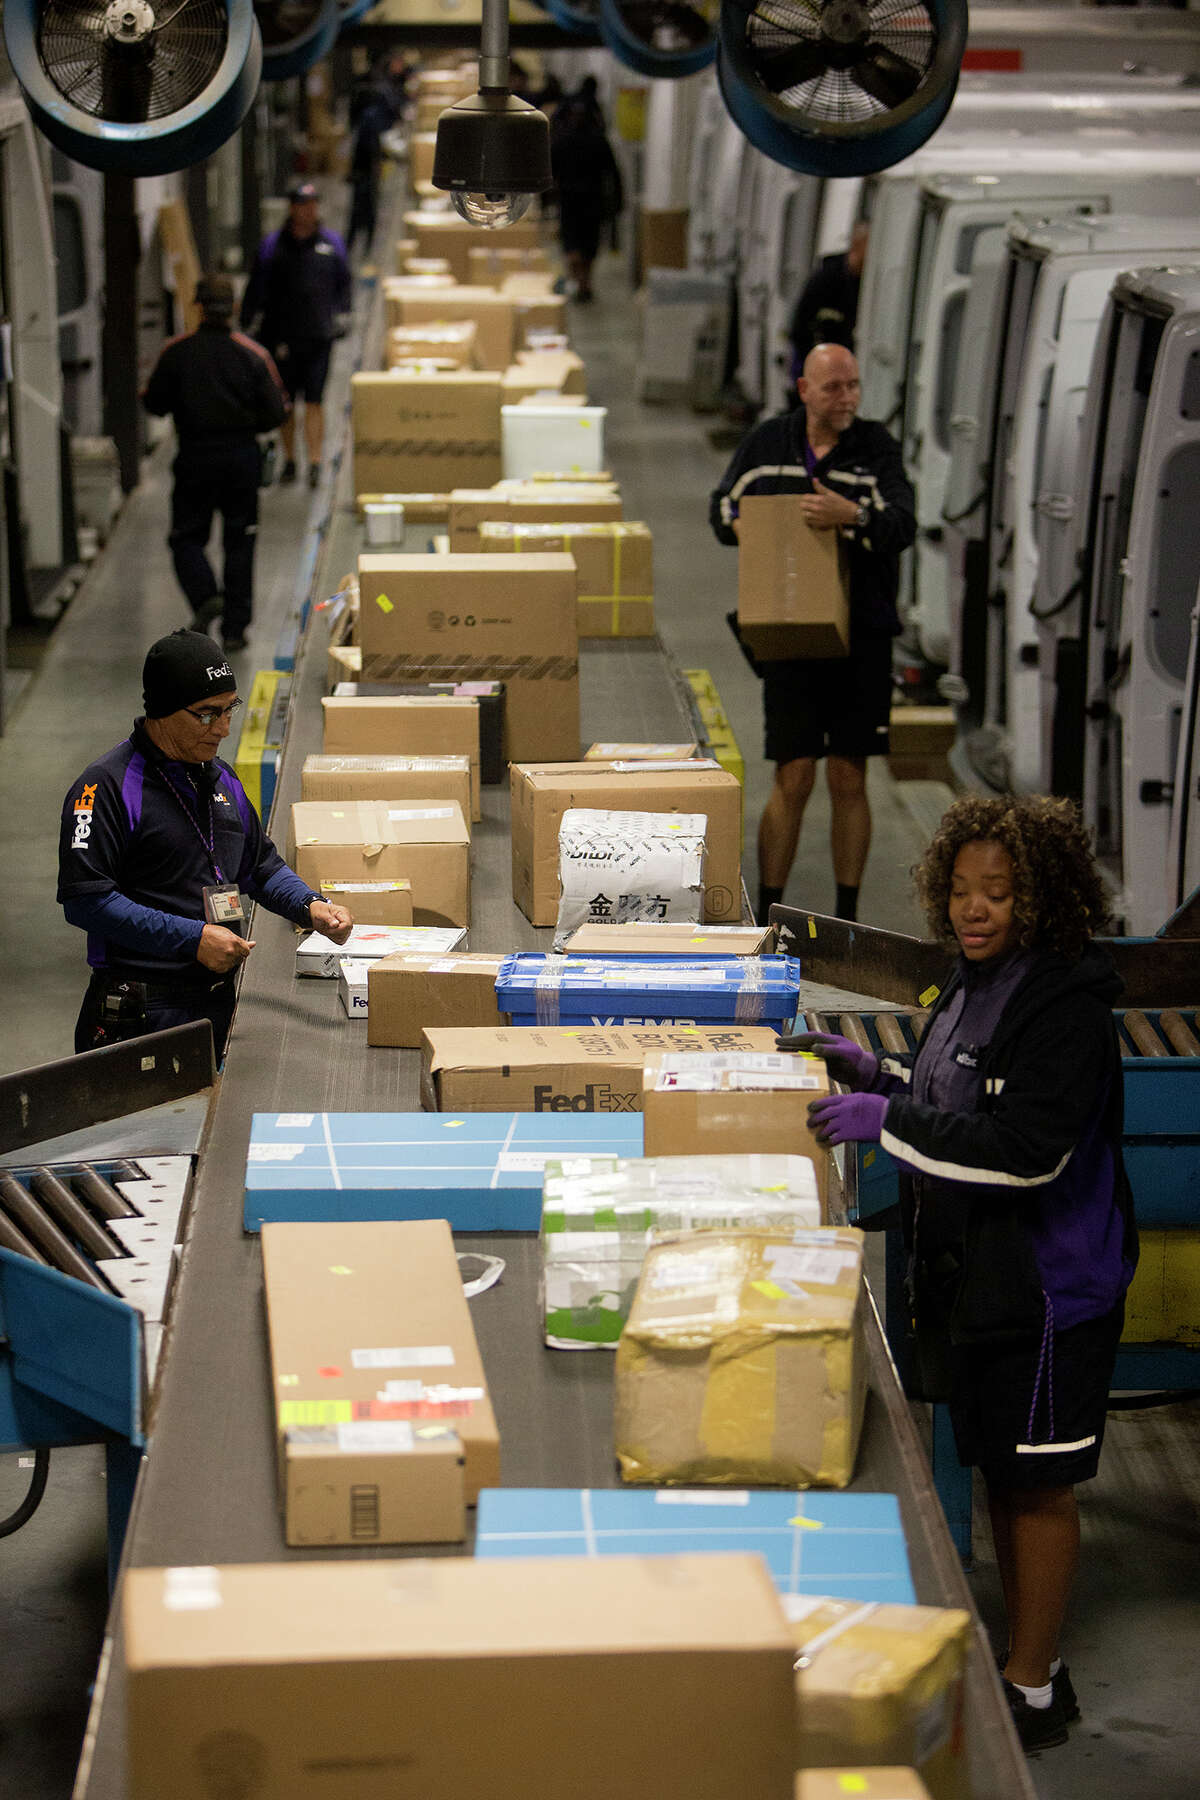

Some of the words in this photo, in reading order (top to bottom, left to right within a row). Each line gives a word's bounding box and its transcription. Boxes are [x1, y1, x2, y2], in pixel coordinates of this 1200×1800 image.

[71, 782, 98, 849] FedEx
[632, 1033, 669, 1049] BOX
[534, 1083, 638, 1112] FedEx
